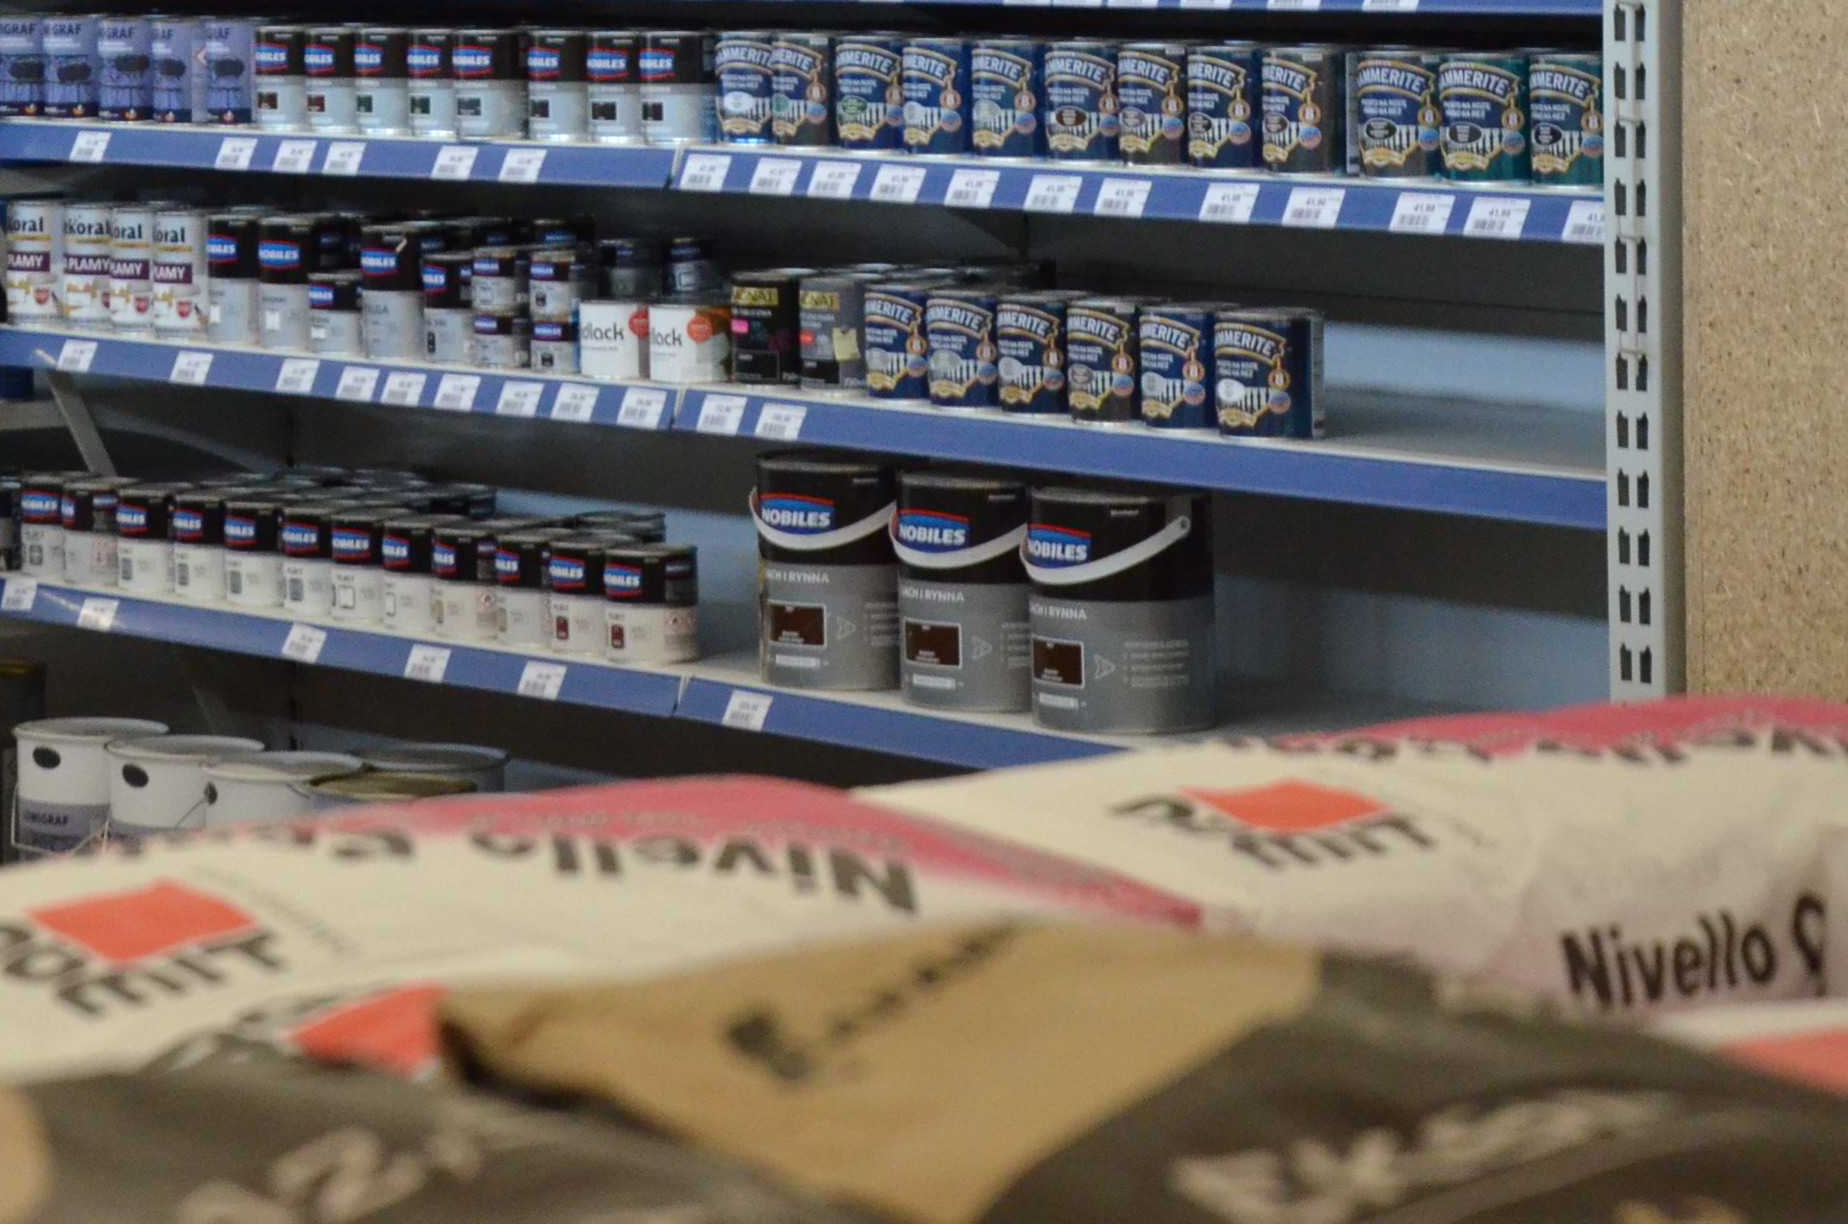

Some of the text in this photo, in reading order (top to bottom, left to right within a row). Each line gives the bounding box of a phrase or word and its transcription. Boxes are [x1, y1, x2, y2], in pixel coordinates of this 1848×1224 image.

[760, 506, 832, 530] NOBILES
[898, 523, 966, 545] NOBILES
[788, 570, 830, 584] RYNNA
[925, 589, 965, 602] RYNNA
[1560, 919, 1777, 1012] Nivello
